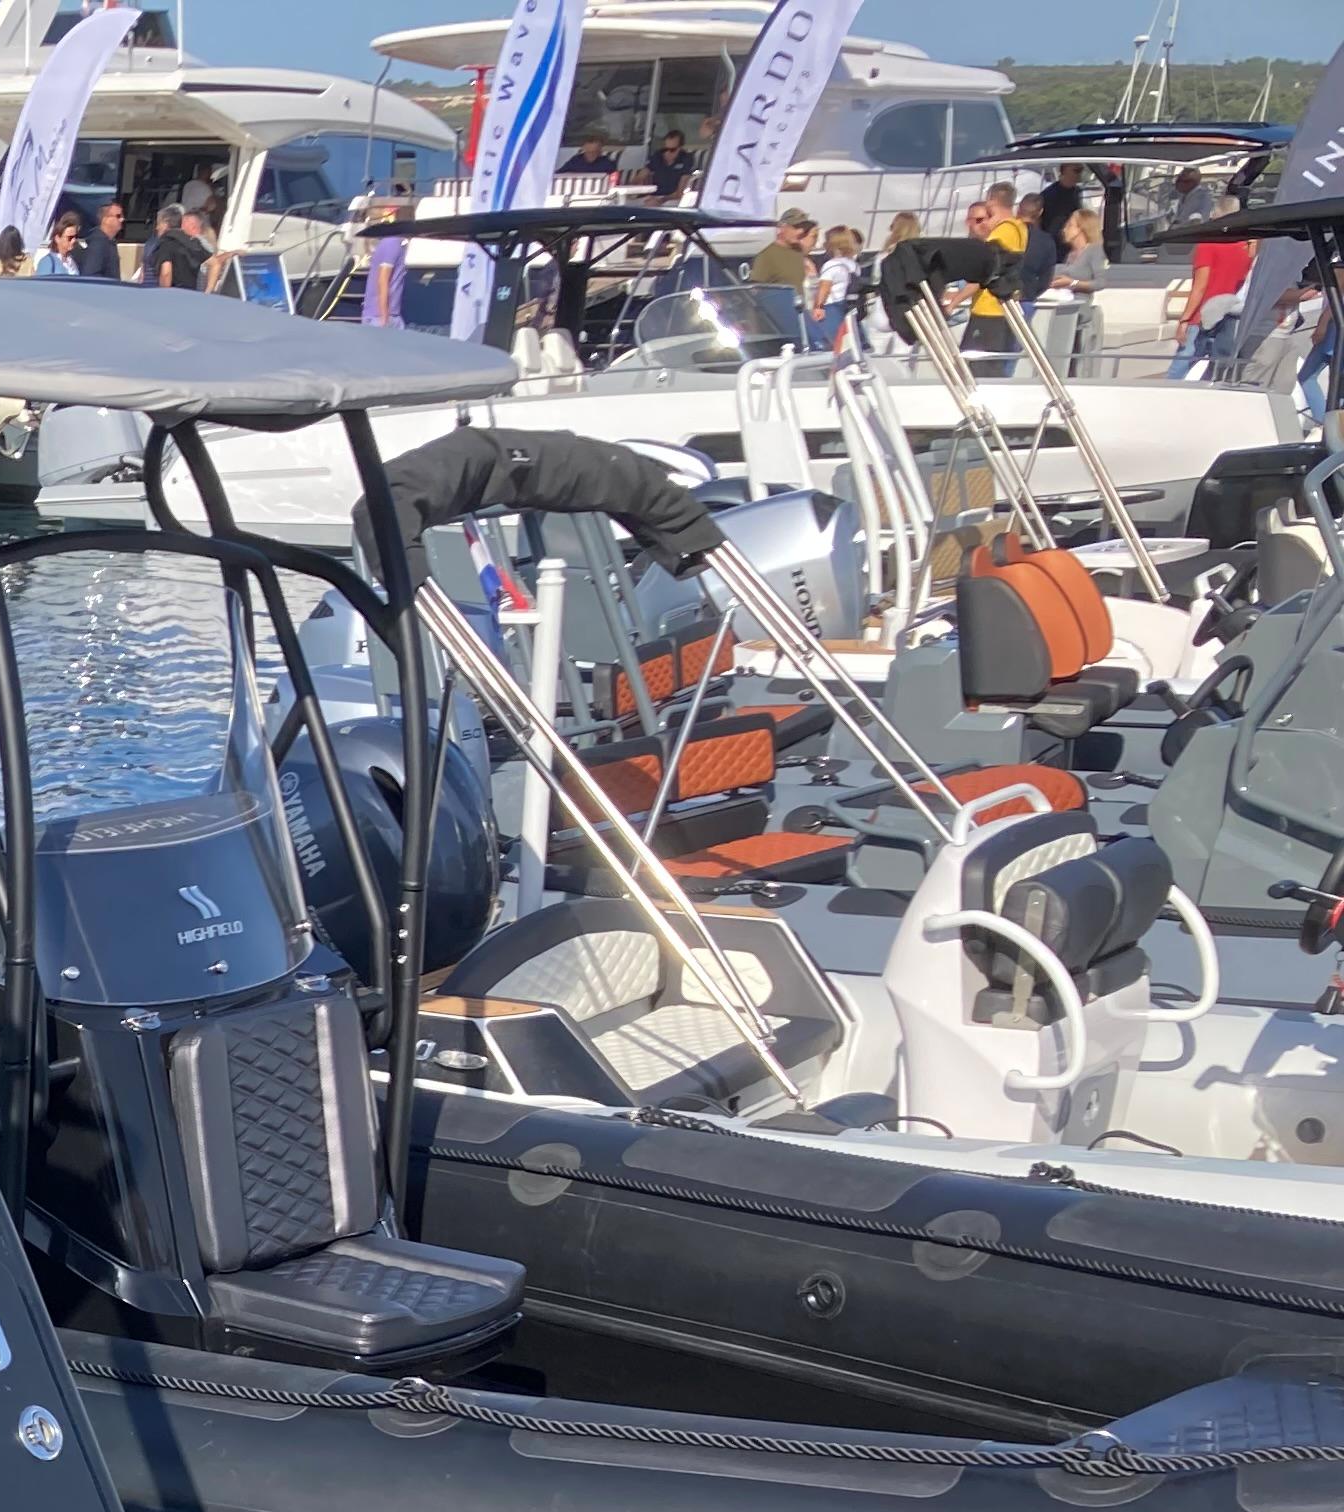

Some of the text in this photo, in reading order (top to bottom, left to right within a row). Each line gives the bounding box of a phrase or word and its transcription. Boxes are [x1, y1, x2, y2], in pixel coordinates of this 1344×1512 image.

[719, 10, 814, 204] PARDO
[791, 567, 823, 640] HOND
[283, 791, 327, 878] YAMAHA
[177, 920, 243, 945] HIGHFIELD
